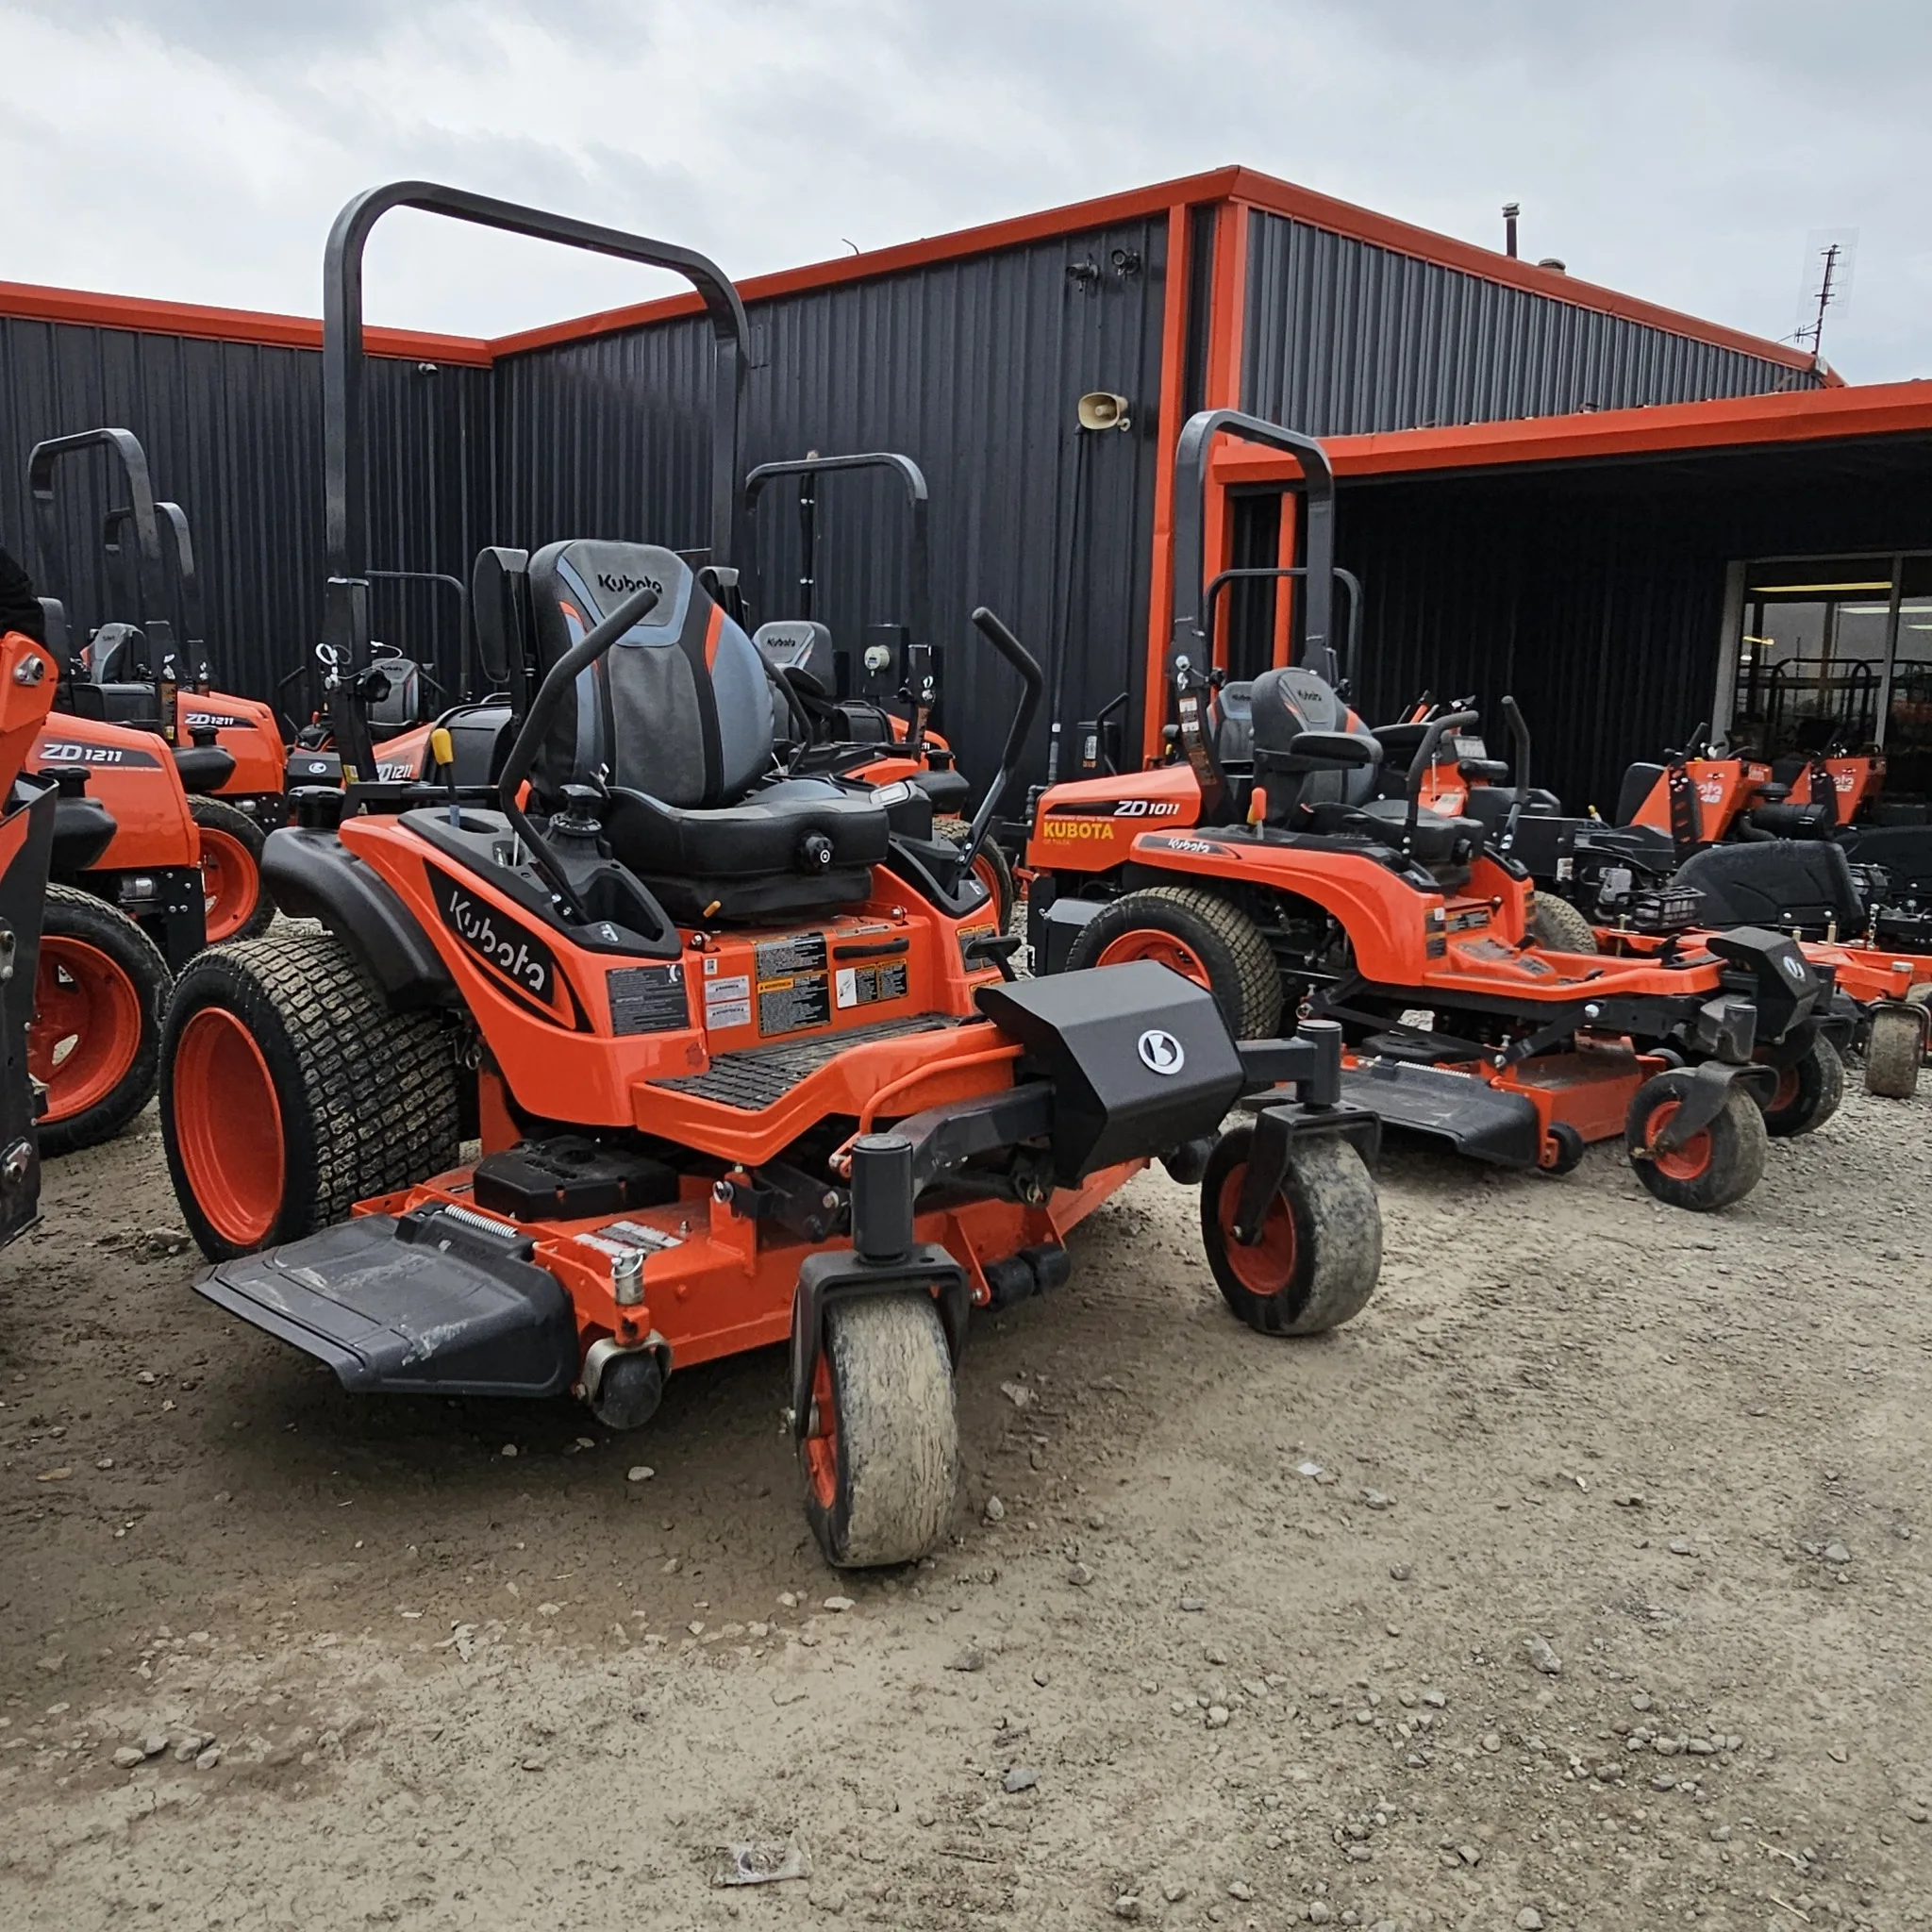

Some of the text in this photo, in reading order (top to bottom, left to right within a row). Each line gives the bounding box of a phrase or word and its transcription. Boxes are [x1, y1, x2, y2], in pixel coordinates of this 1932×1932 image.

[597, 574, 663, 594] Kubota
[766, 637, 796, 648] Kubota
[1043, 822, 1114, 840] KUBOTA
[1168, 838, 1210, 854] Kubota
[449, 891, 545, 991] Kubota
